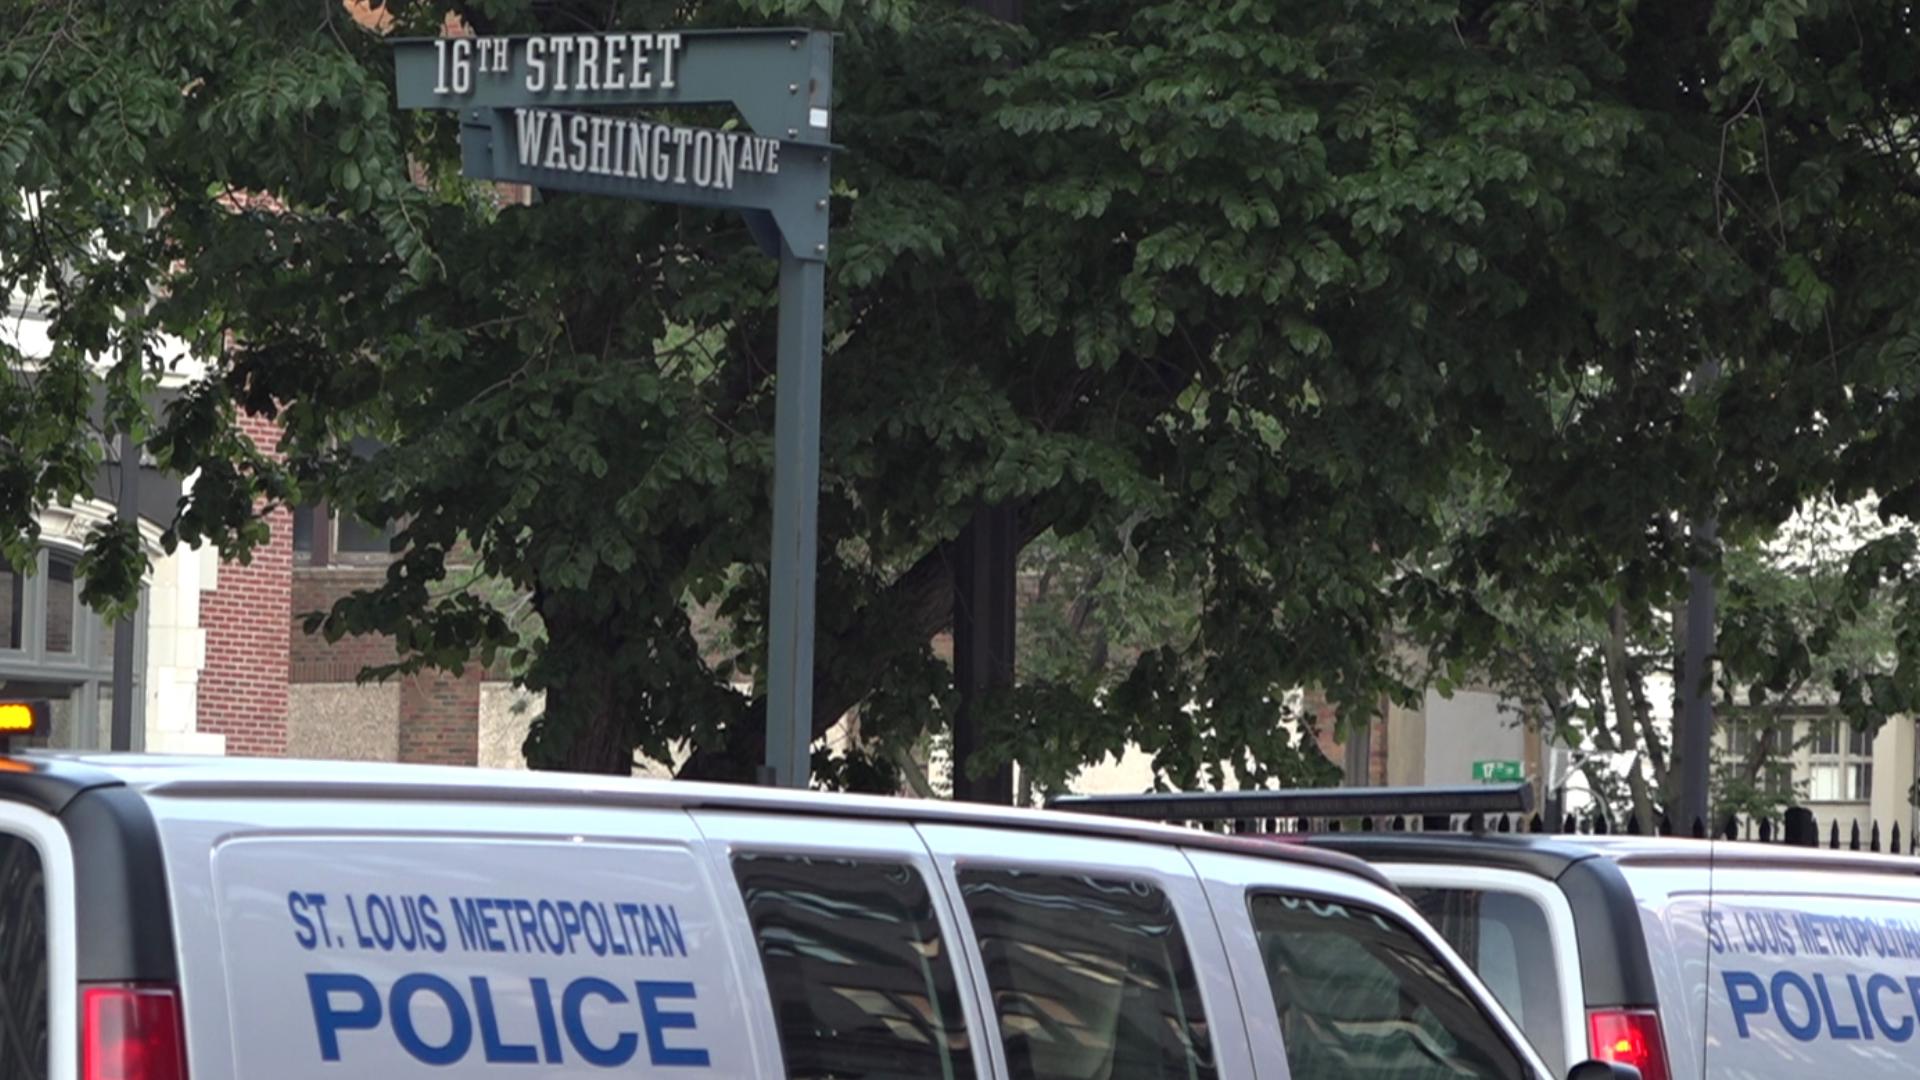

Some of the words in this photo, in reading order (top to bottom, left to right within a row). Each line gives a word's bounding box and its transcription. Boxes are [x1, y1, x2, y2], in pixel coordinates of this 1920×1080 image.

[433, 38, 509, 94] 16TH
[525, 33, 682, 92] STREET
[515, 108, 738, 190] WASHINGTON
[739, 137, 780, 174] AVE
[288, 891, 344, 950] ST.
[345, 893, 448, 954] LOUIS
[450, 897, 688, 958] METROPOLITAN
[1701, 911, 1740, 954] ST.
[1733, 911, 1796, 956] LOUIS
[305, 972, 711, 1067] POLICE
